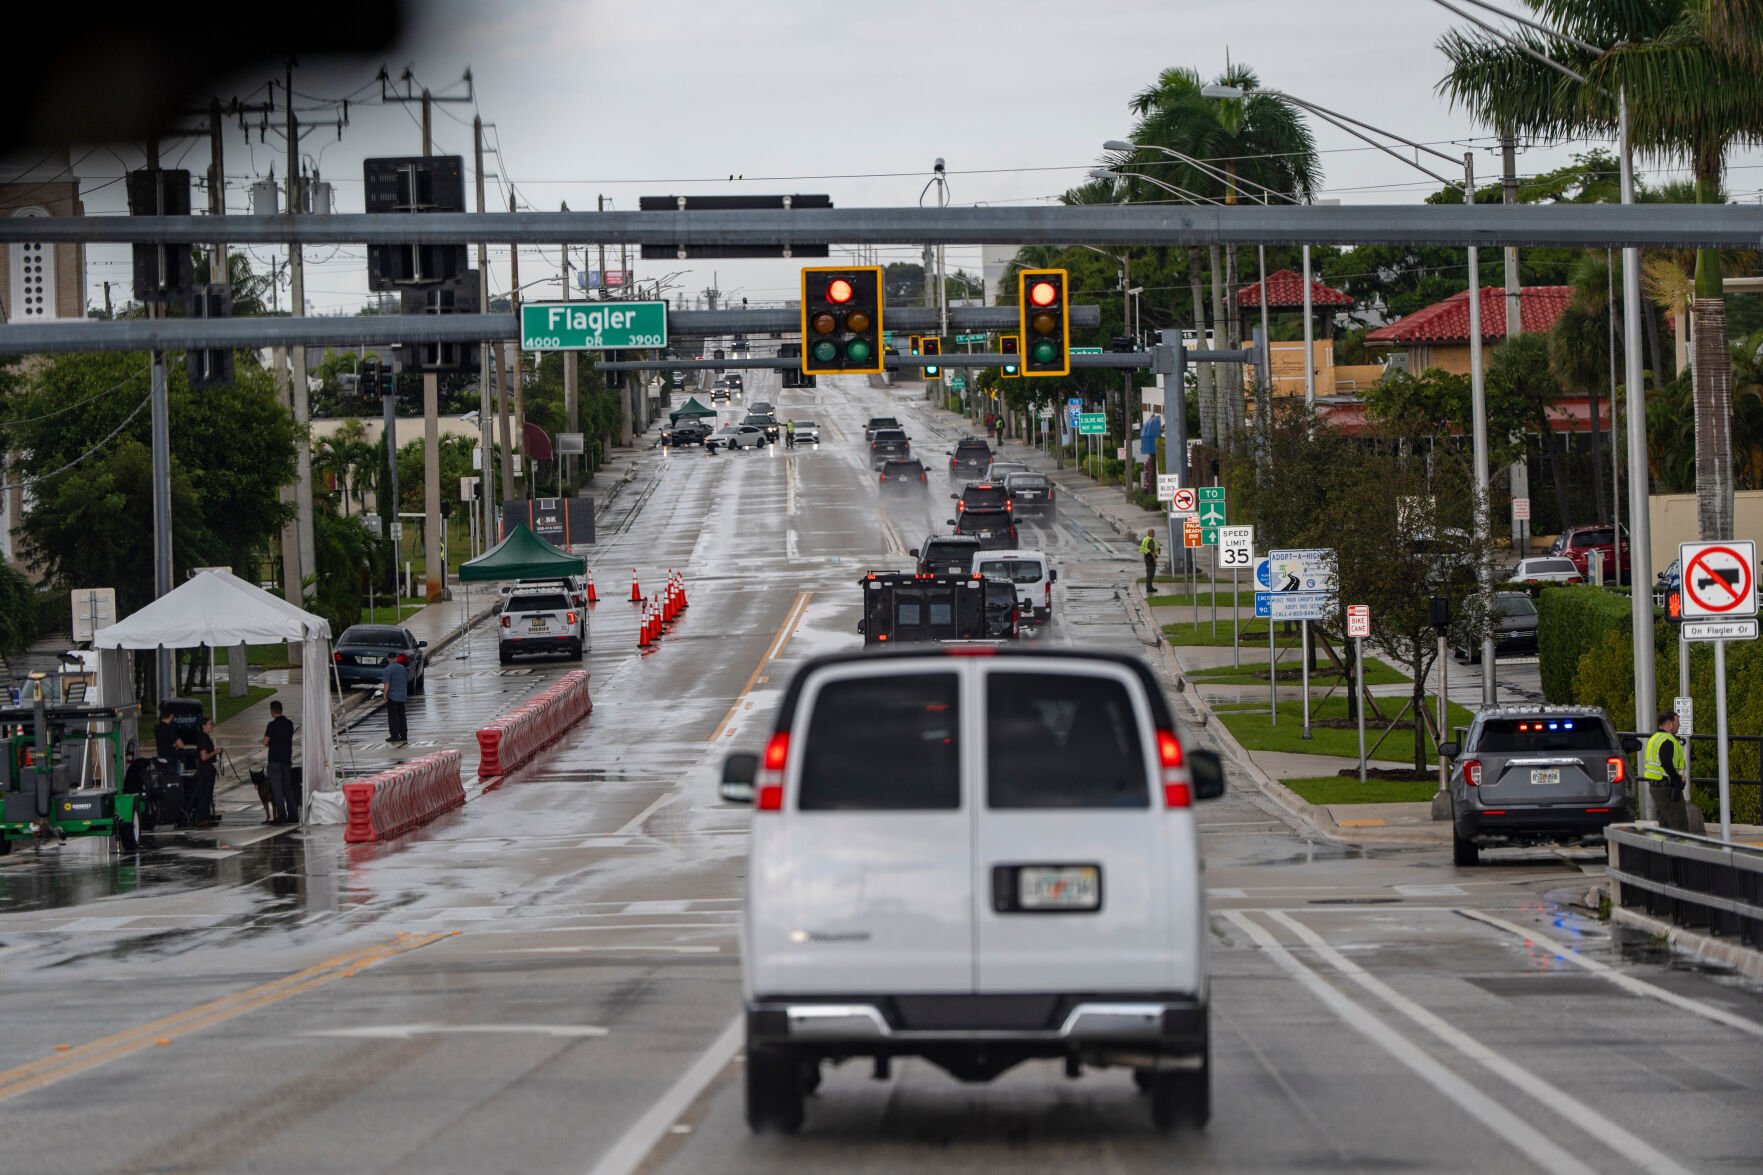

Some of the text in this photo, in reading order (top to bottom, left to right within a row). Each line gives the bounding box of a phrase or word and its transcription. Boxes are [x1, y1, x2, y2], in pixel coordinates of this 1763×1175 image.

[548, 307, 636, 336] Flagler
[525, 335, 662, 347] 4000 DR 3900
[1070, 408, 1081, 416] 95
[1205, 490, 1218, 498] TO
[1224, 548, 1249, 564] 35
[1691, 625, 1748, 636] On Flagler Dr
